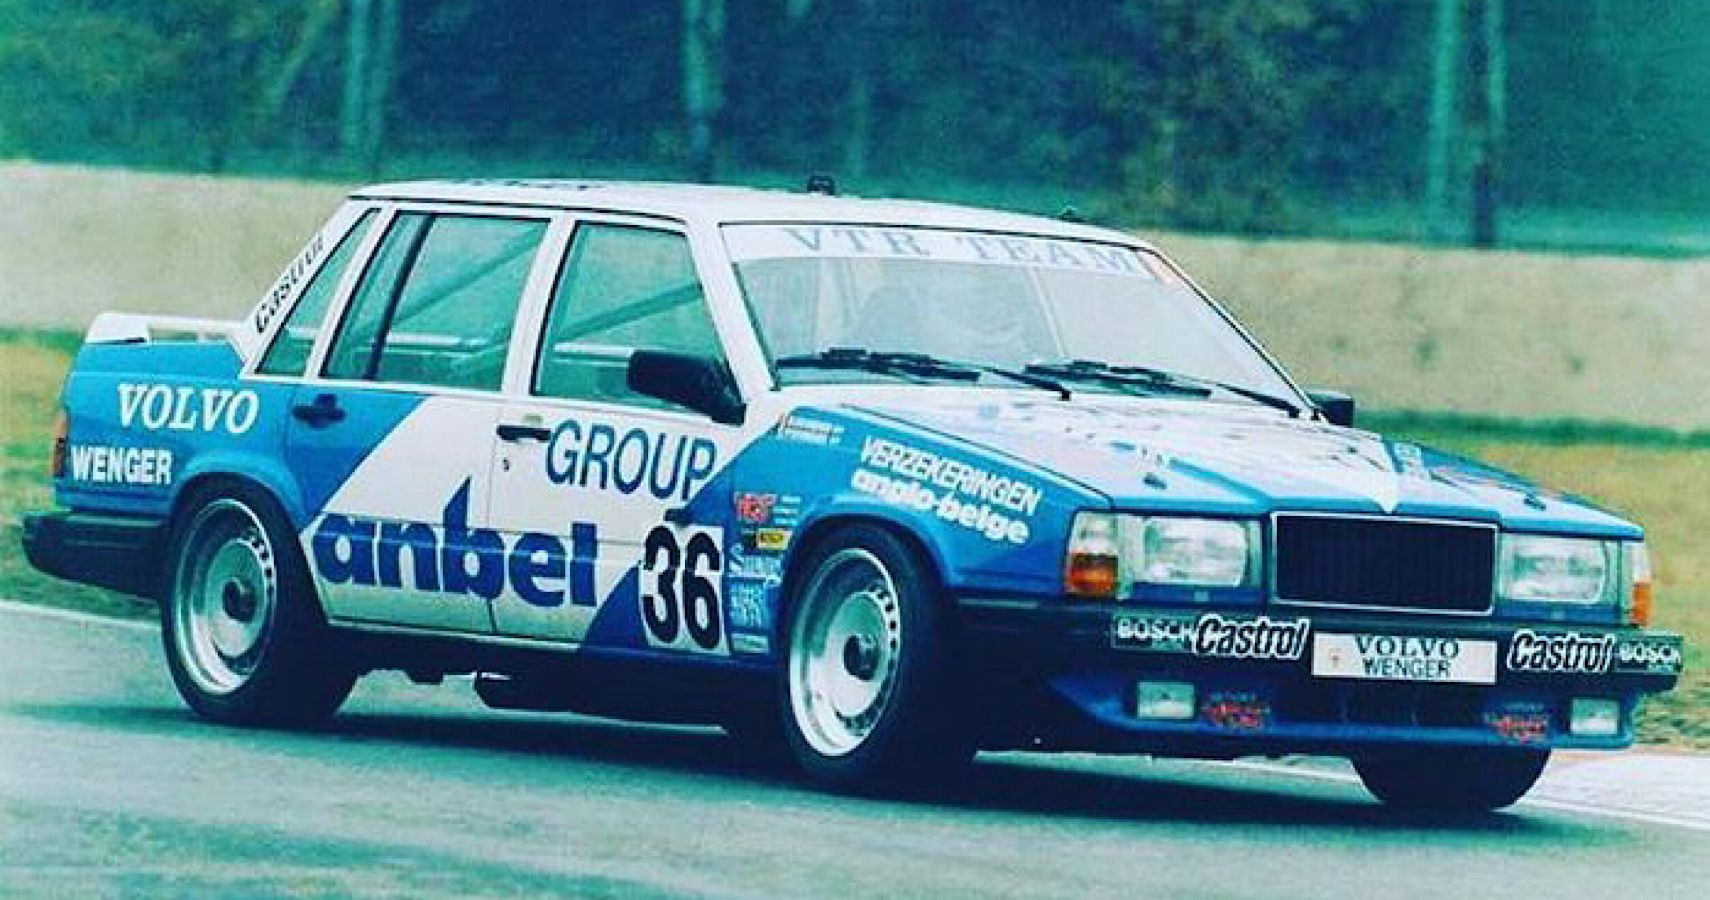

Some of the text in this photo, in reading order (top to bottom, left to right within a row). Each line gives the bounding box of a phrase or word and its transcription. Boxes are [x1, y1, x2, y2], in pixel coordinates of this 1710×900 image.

[785, 227, 1141, 273] VTR TEAM
[117, 383, 260, 434] VOLVO
[71, 445, 173, 485] WENGER
[546, 420, 717, 501] GROUP
[861, 435, 1043, 516] VERZEKERINGEN
[313, 476, 597, 607] anbel
[641, 525, 721, 650] 36
[1117, 618, 1197, 645] BOSCH
[1194, 613, 1310, 660] Castrol
[1355, 635, 1460, 659] VOLVO
[1507, 628, 1616, 673] Castrol
[1363, 658, 1452, 678] WENGER
